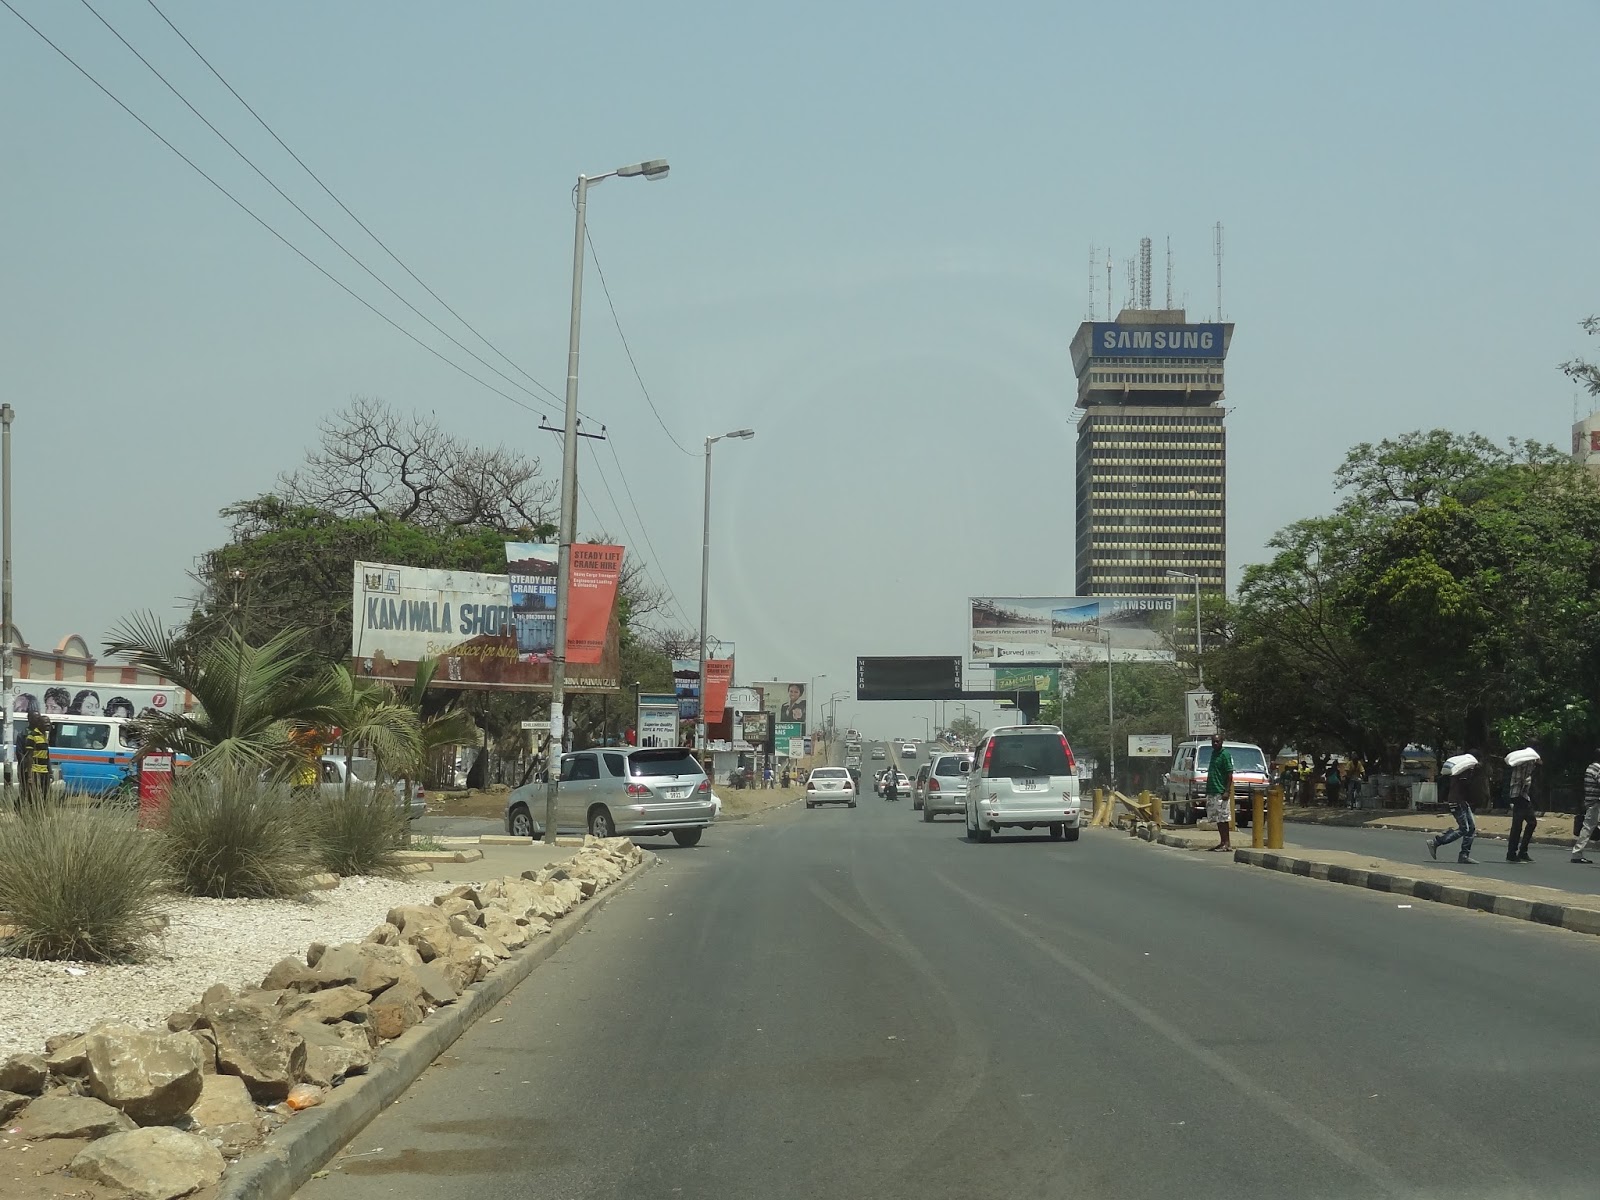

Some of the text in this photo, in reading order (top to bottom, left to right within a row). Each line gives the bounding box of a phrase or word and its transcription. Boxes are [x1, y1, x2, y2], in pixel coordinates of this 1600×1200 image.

[1103, 330, 1213, 349] SAMSUNG
[574, 551, 620, 561] STEADY LIFT
[574, 560, 617, 570] CRANE HIRE
[510, 575, 557, 585] STEADY LIFT
[512, 585, 557, 594] CRANE HIRE
[1113, 600, 1172, 610] SAMSUNG
[367, 596, 453, 634] KAMWALA
[426, 640, 452, 655] Best
[455, 643, 480, 657] place
[480, 644, 495, 662] for
